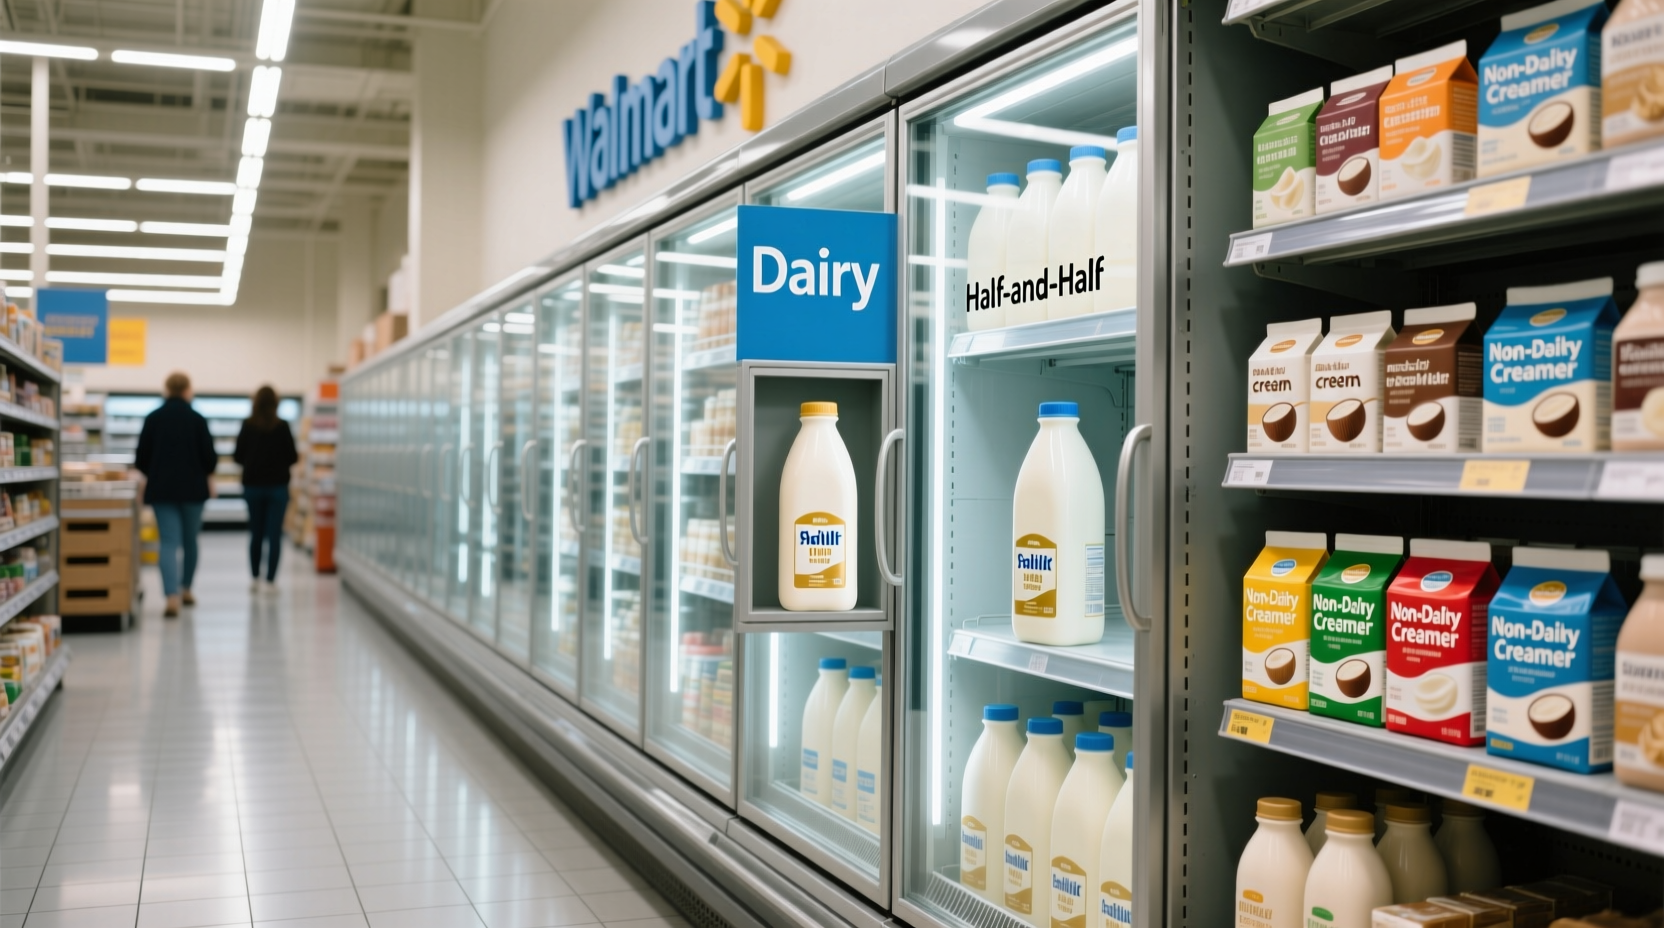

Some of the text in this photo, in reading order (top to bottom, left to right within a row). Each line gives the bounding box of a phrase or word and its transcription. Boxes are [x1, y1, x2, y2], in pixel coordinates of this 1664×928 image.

[1486, 70, 1573, 104] Creamer
[562, 0, 724, 208] Walmart
[752, 245, 880, 311] Dairy
[966, 255, 1105, 312] Half-and-Half
[1490, 362, 1578, 384] Creamer
[1246, 605, 1297, 625] Creamer
[1313, 612, 1374, 636] Creamer
[1391, 622, 1459, 648] Creamer
[1494, 638, 1576, 669] Creamer
